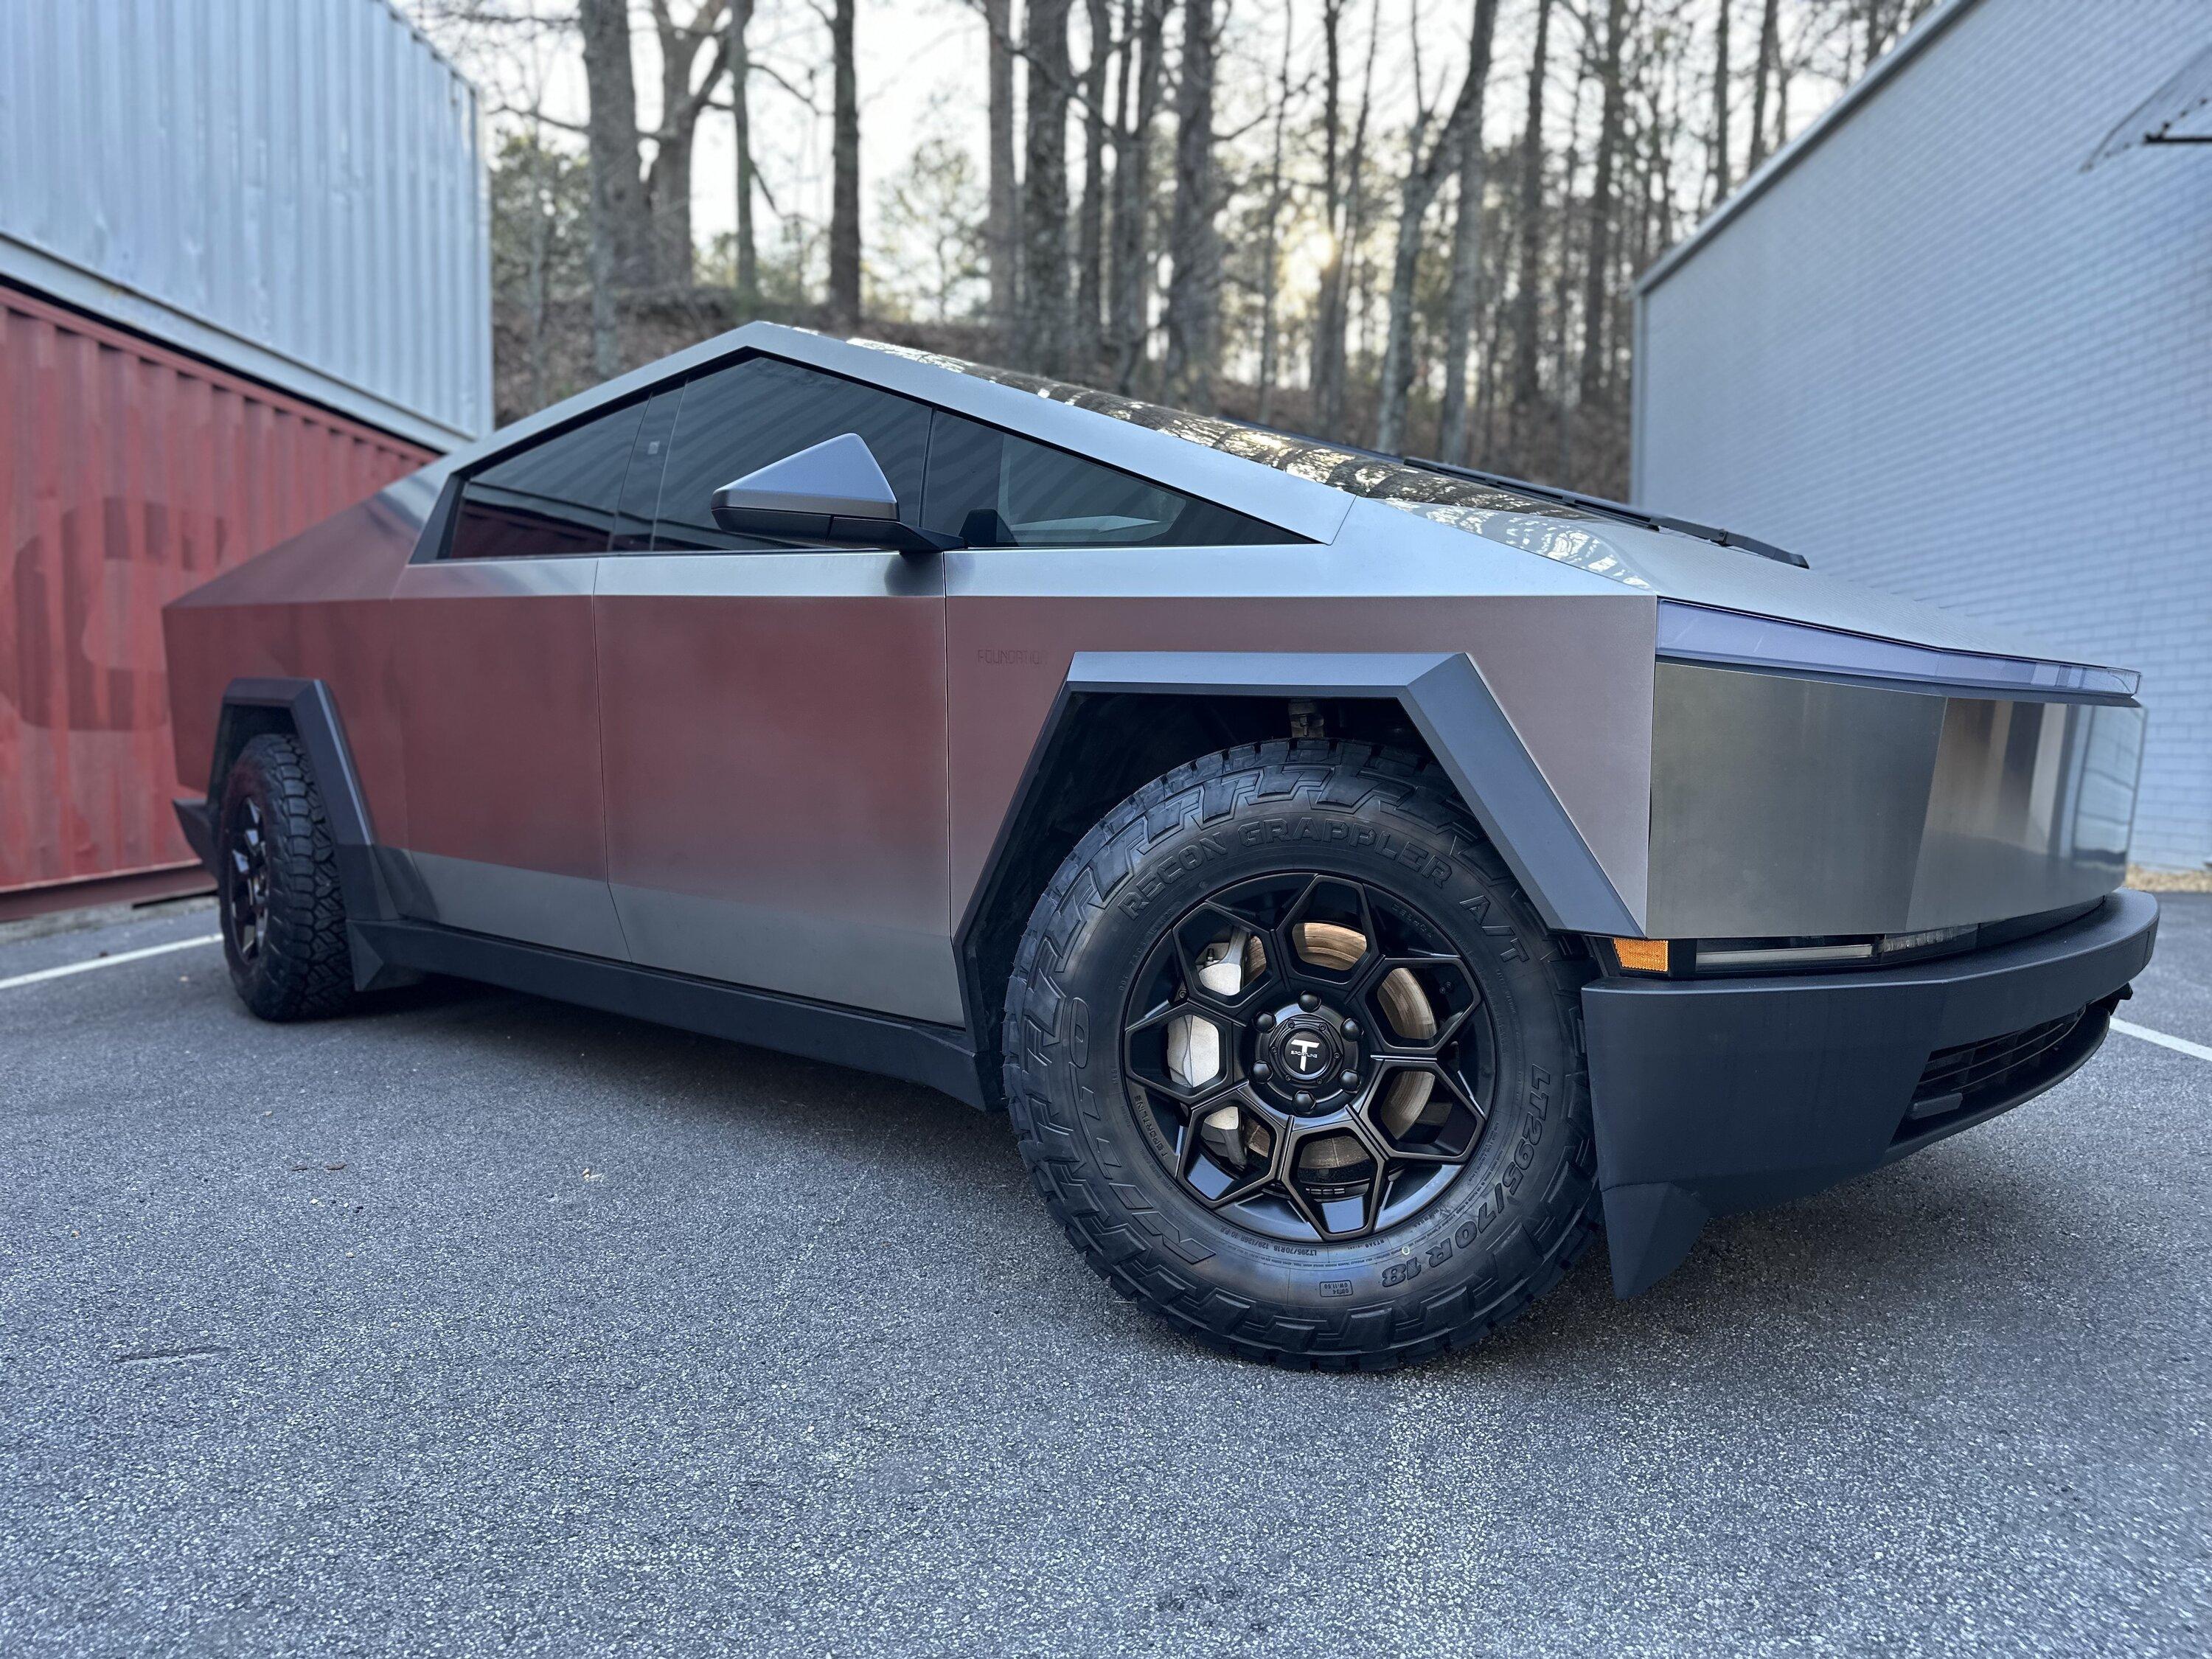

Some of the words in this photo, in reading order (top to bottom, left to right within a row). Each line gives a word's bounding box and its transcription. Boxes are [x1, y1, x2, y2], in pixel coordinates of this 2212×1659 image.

[1118, 832, 1229, 920] RECON
[1237, 816, 1453, 889] GRAPPLER
[1459, 894, 1530, 963] A/T
[1069, 997, 1217, 1265] NITTO
